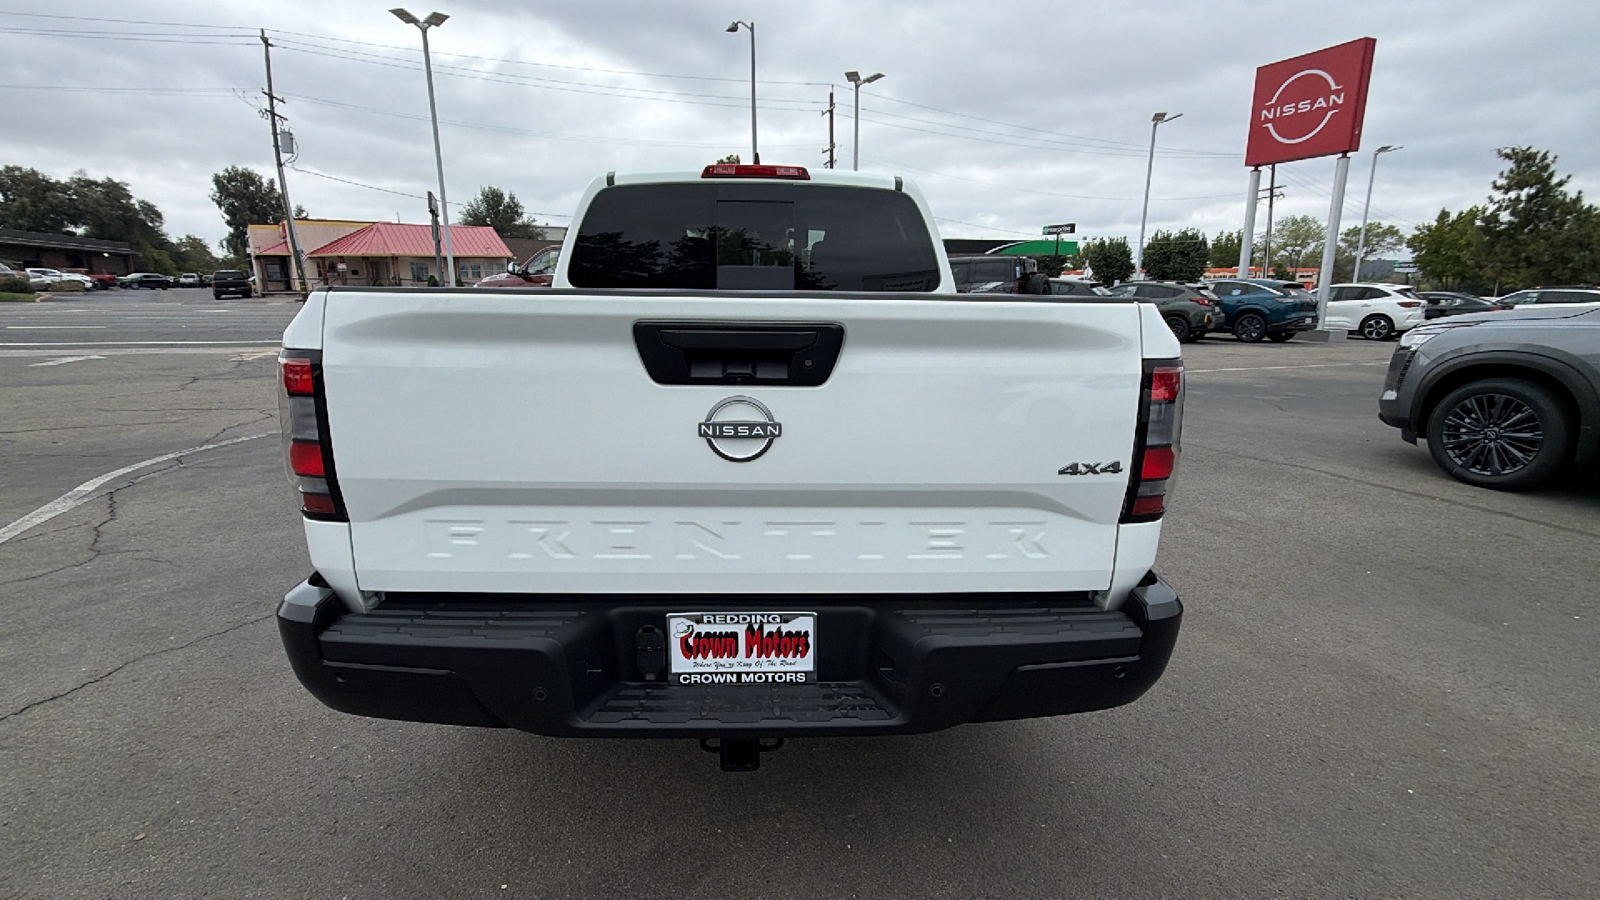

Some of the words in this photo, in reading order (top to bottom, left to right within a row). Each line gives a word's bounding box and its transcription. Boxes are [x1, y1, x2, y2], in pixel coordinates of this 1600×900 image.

[1261, 92, 1345, 121] NISSAN
[701, 425, 779, 436] NISSAN
[423, 520, 1049, 559] FRONTIER
[703, 615, 781, 624] REDDING
[680, 631, 738, 660] Crown
[745, 626, 809, 659] Motors
[736, 661, 753, 669] King
[755, 660, 764, 669] Of
[680, 674, 737, 684] CROWN
[741, 673, 806, 683] MOTORS
